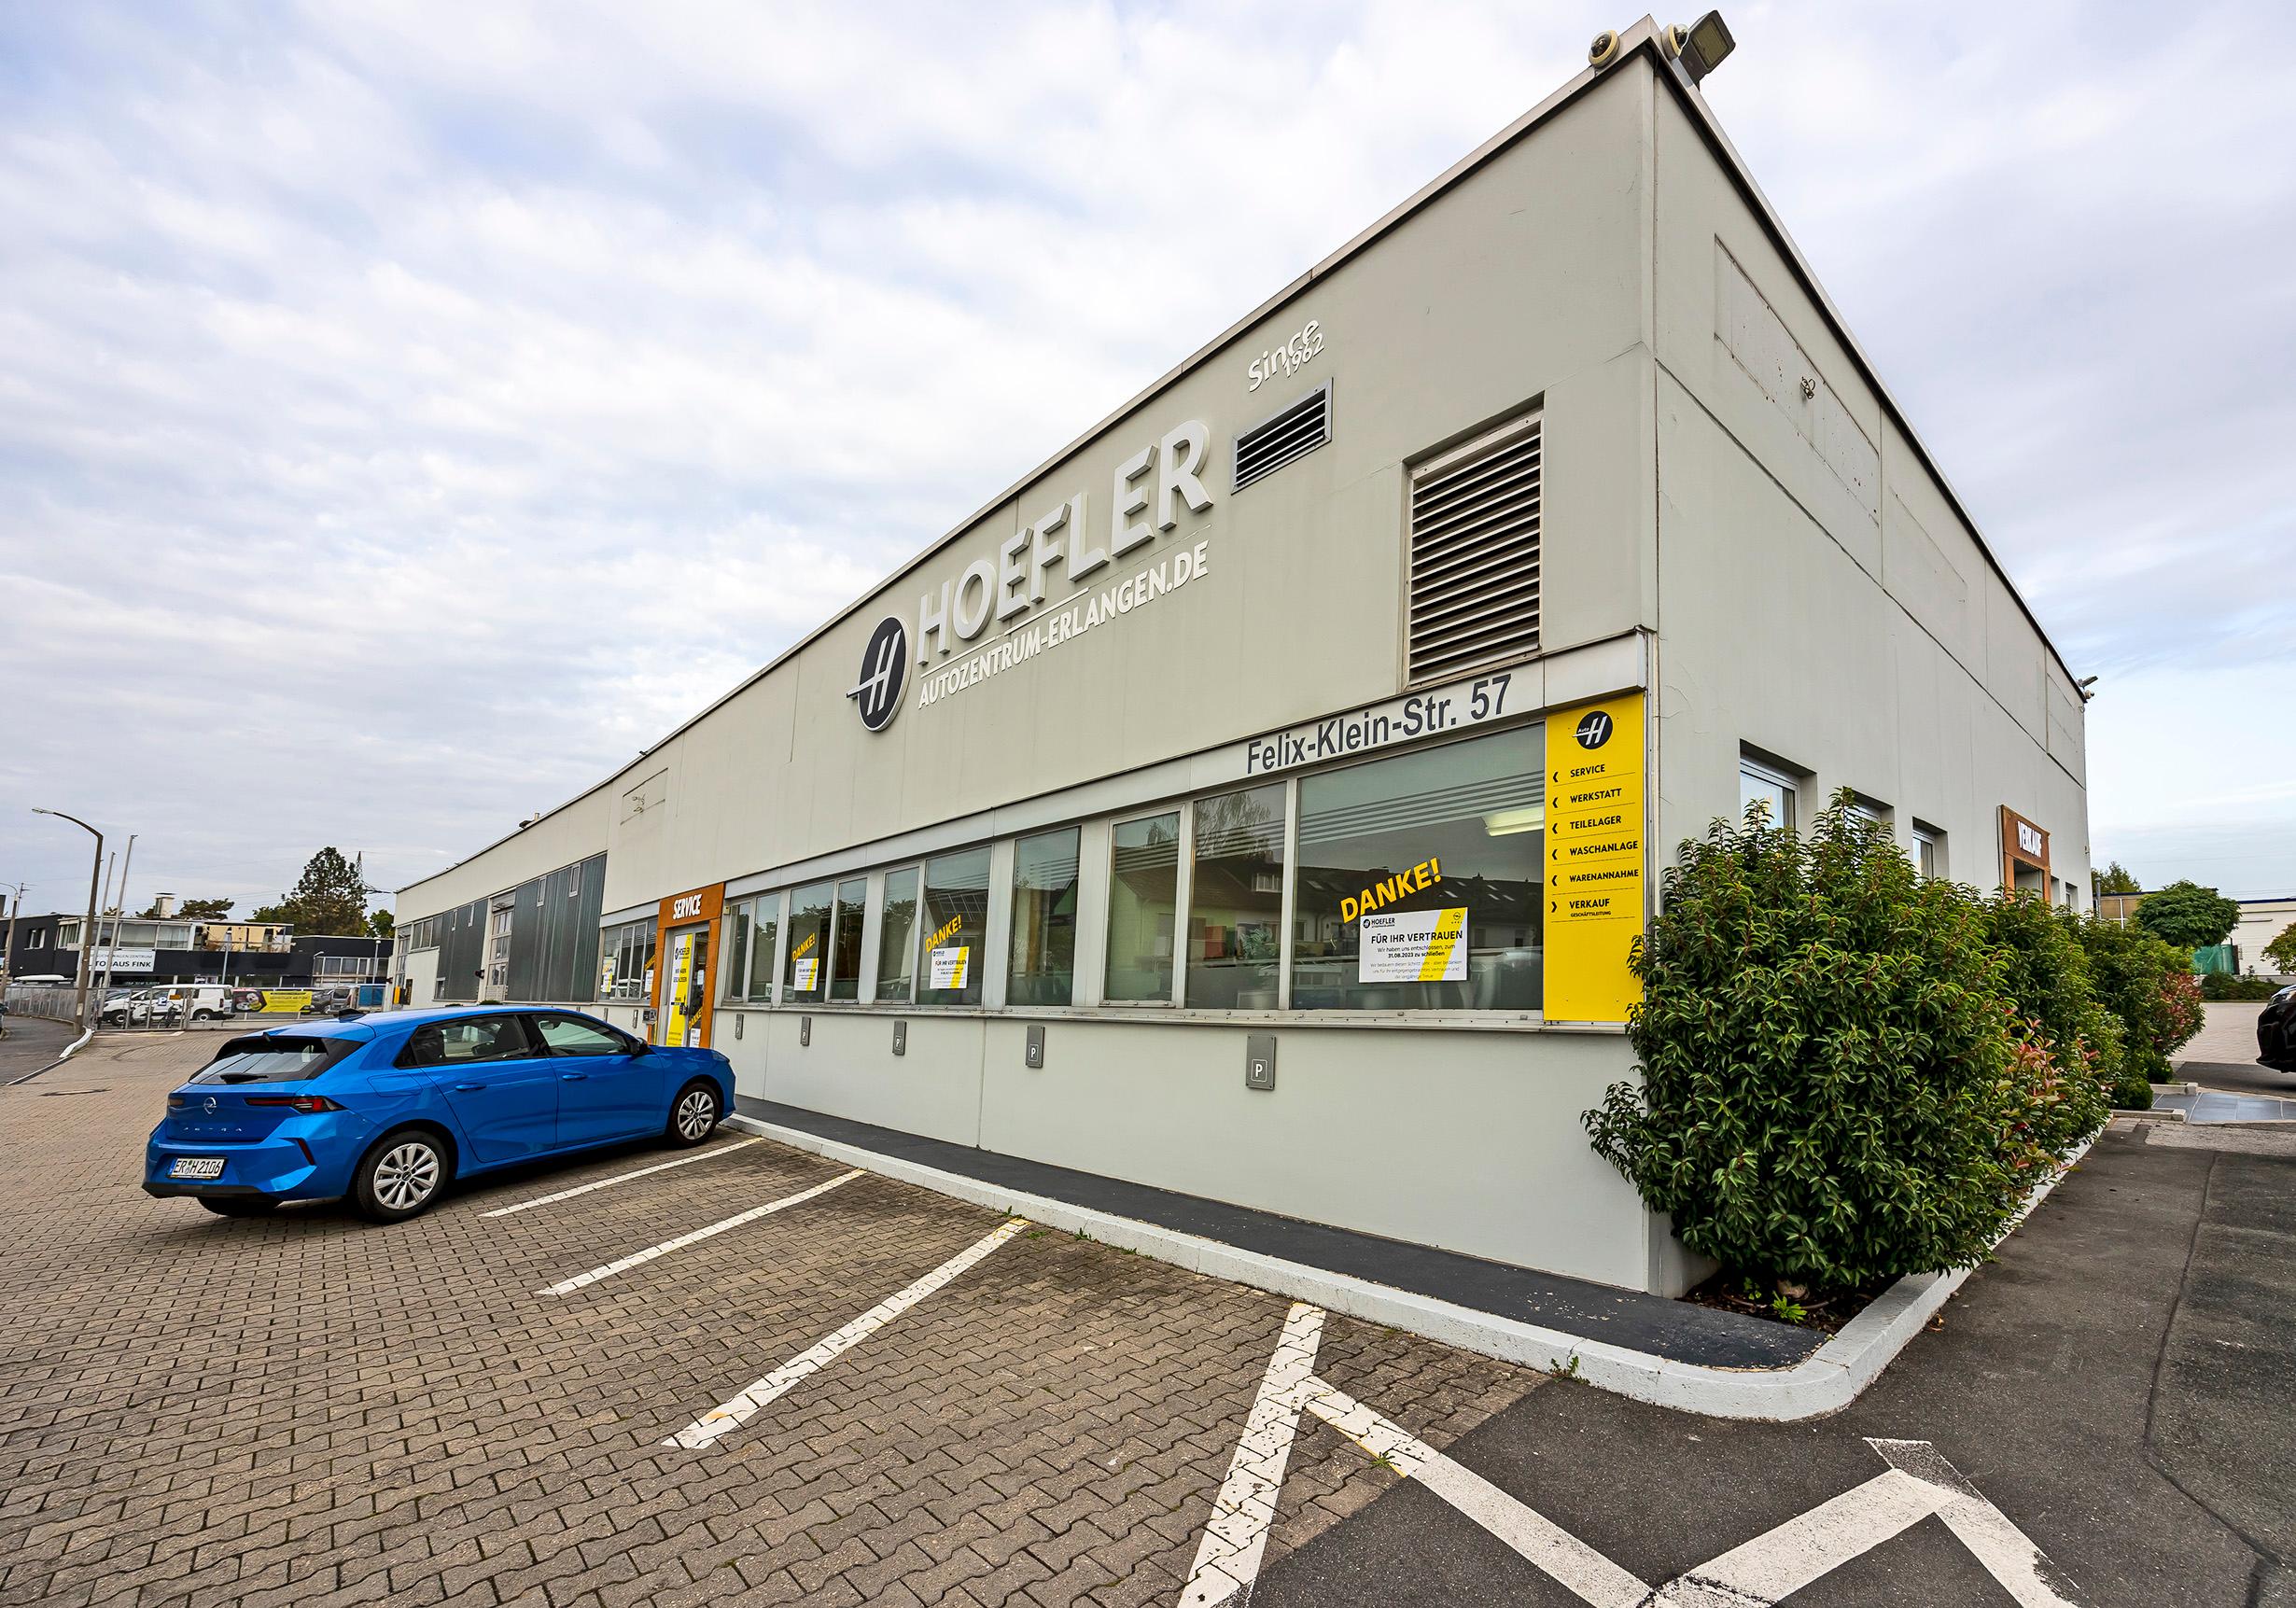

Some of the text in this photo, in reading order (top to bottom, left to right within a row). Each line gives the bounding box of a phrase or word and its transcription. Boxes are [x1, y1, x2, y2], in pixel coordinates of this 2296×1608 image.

[1248, 320, 1319, 392] Since
[1283, 333, 1324, 378] 1962
[917, 419, 1213, 666] HOEFLER
[918, 539, 1210, 710] AUTOZENTRUM-ERLANGEN.DE
[1247, 674, 1512, 774] Felix-Klein-Str. 57
[1570, 764, 1605, 777] SERVICE
[1570, 788, 1622, 804] WERKSTATT
[1570, 815, 1622, 830] TEILELAGER
[1569, 840, 1638, 856] WASCHANLAGE
[1569, 869, 1639, 882] WARENANNAHME
[1340, 857, 1442, 923] DANKE!
[672, 894, 702, 920] SERVICE
[1569, 898, 1610, 909] VERKAUF
[925, 915, 962, 953] DANKE!
[1371, 930, 1463, 944] FÜR IHR VERTRAUEN
[792, 933, 815, 962] DANKE!
[896, 1038, 900, 1047] P
[1031, 1048, 1036, 1058] P
[1255, 1063, 1263, 1077] P
[174, 1161, 187, 1173] ER
[197, 1161, 221, 1174] 2106
